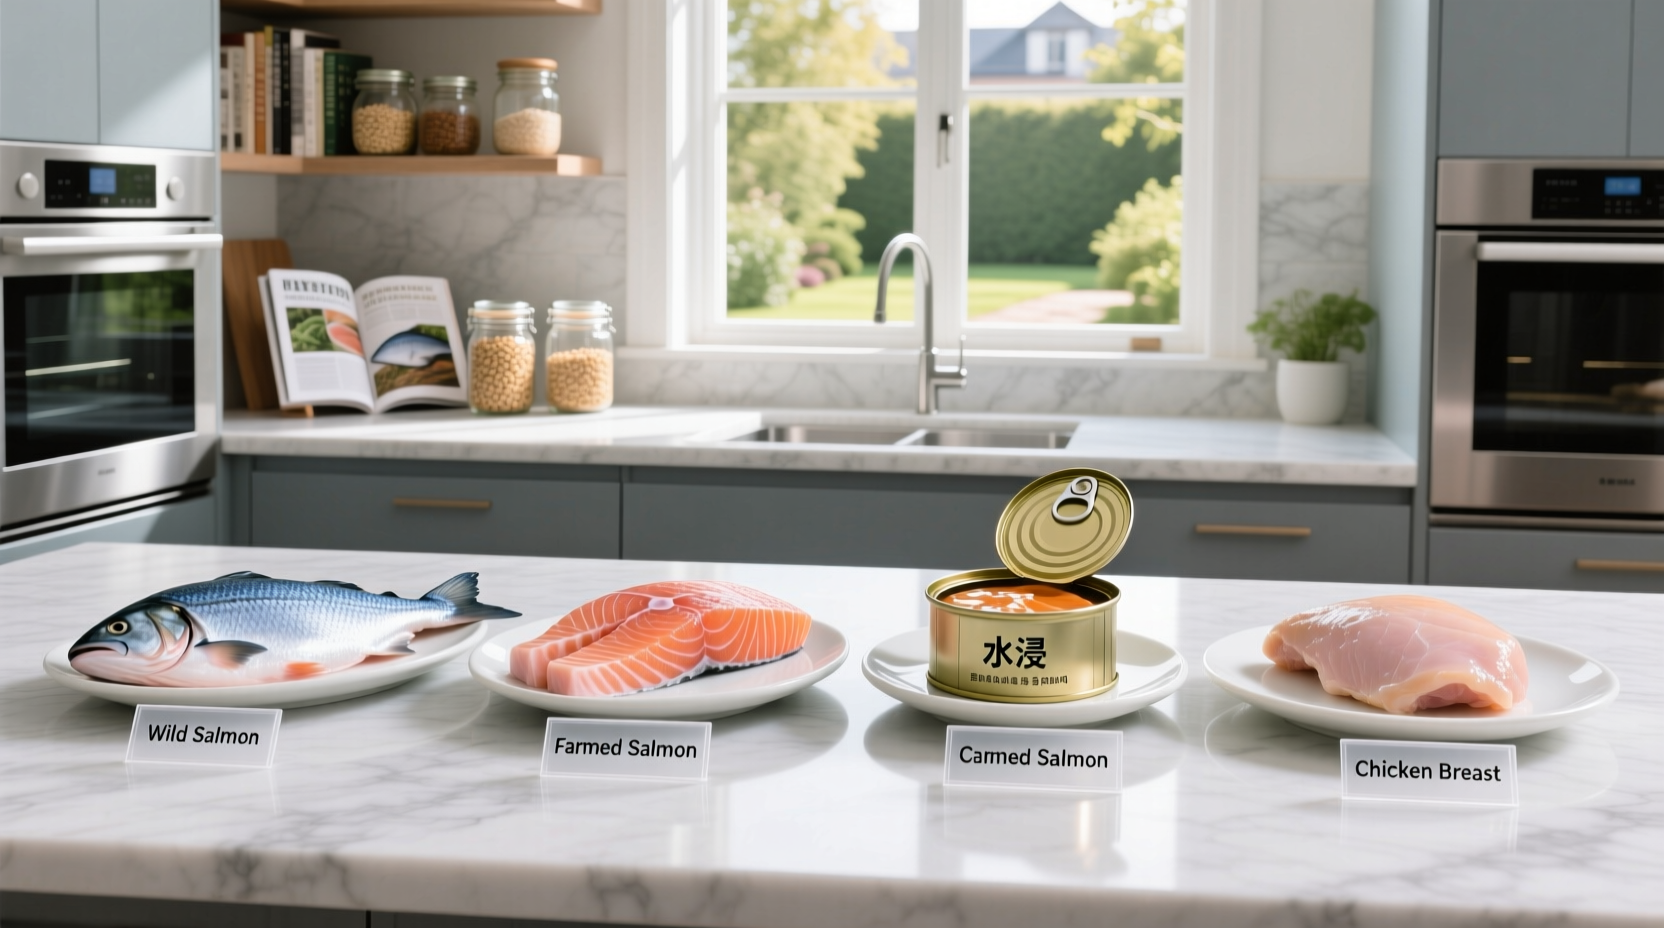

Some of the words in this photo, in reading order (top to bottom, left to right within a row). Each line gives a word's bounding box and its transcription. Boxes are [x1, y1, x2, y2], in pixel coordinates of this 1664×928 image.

[982, 635, 1047, 670] 水浸
[148, 723, 189, 743] Wild
[192, 725, 260, 746] Salmon
[554, 737, 623, 756] Farmed
[627, 739, 697, 759] Salmon
[1037, 748, 1108, 769] Salmon
[1355, 759, 1433, 780] Chicken
[1439, 762, 1502, 782] Breast
